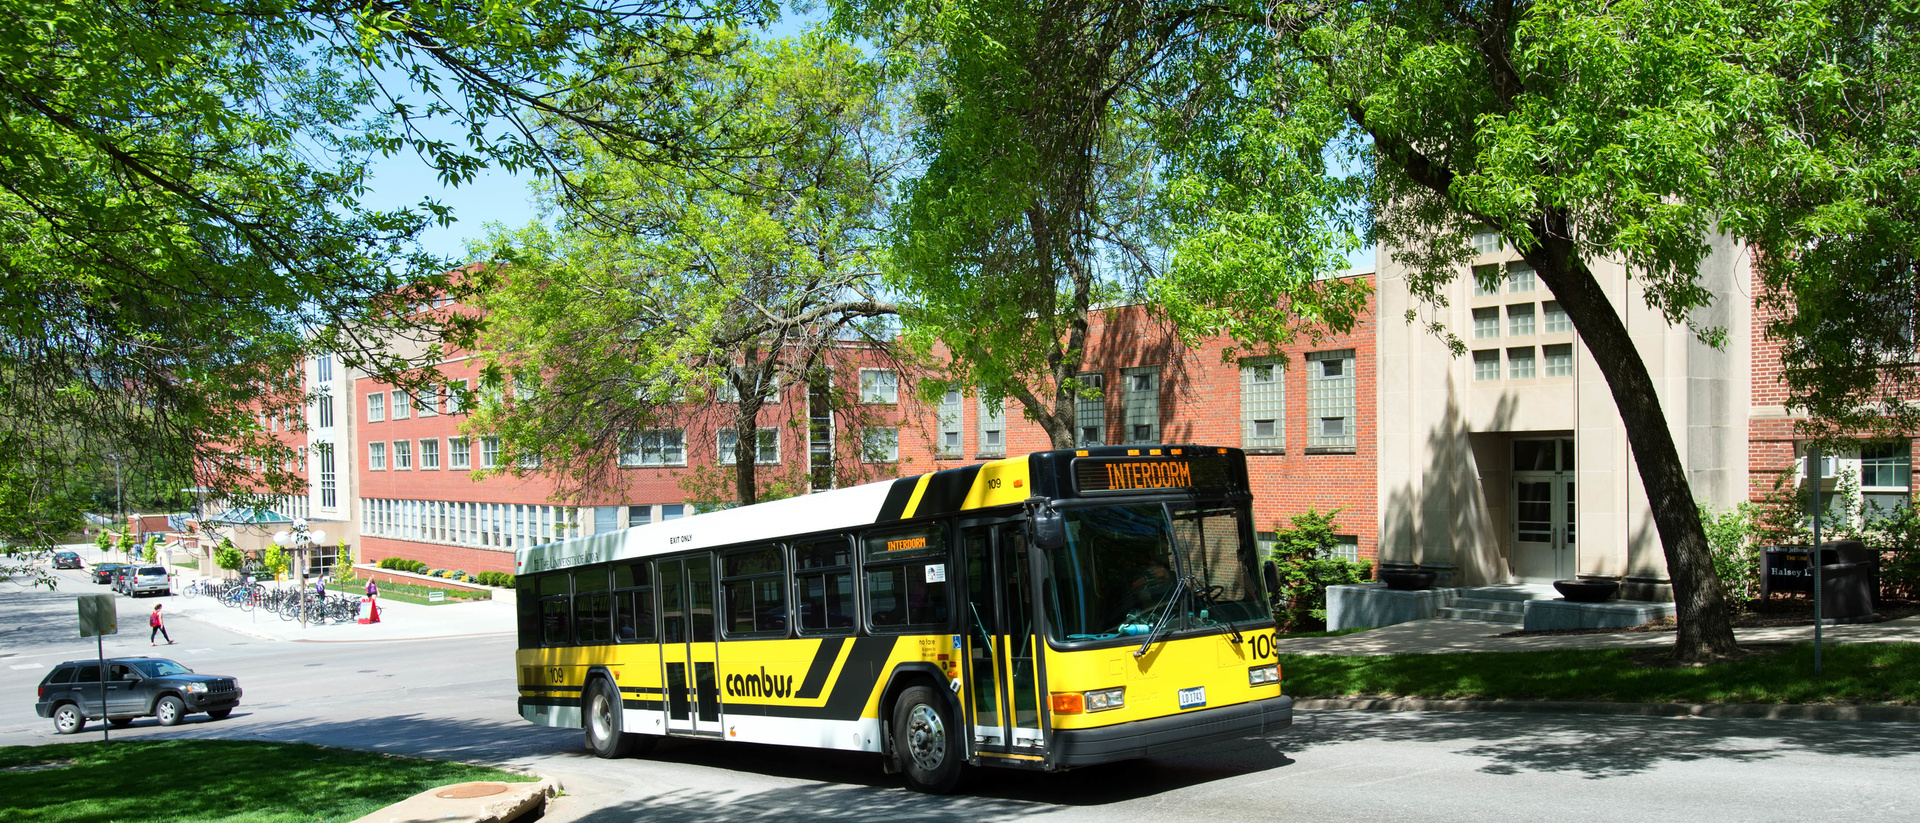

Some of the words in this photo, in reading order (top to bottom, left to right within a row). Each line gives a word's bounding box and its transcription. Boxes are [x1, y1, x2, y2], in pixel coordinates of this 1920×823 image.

[1105, 461, 1192, 490] INTERDORM
[987, 478, 1001, 490] 109
[670, 536, 680, 544] EXIT
[681, 534, 693, 543] ONLY
[887, 537, 926, 551] INTERDORM
[1771, 568, 1801, 577] Halsey
[1248, 632, 1278, 660] 109
[550, 667, 564, 684] 109
[726, 666, 793, 698] cambus
